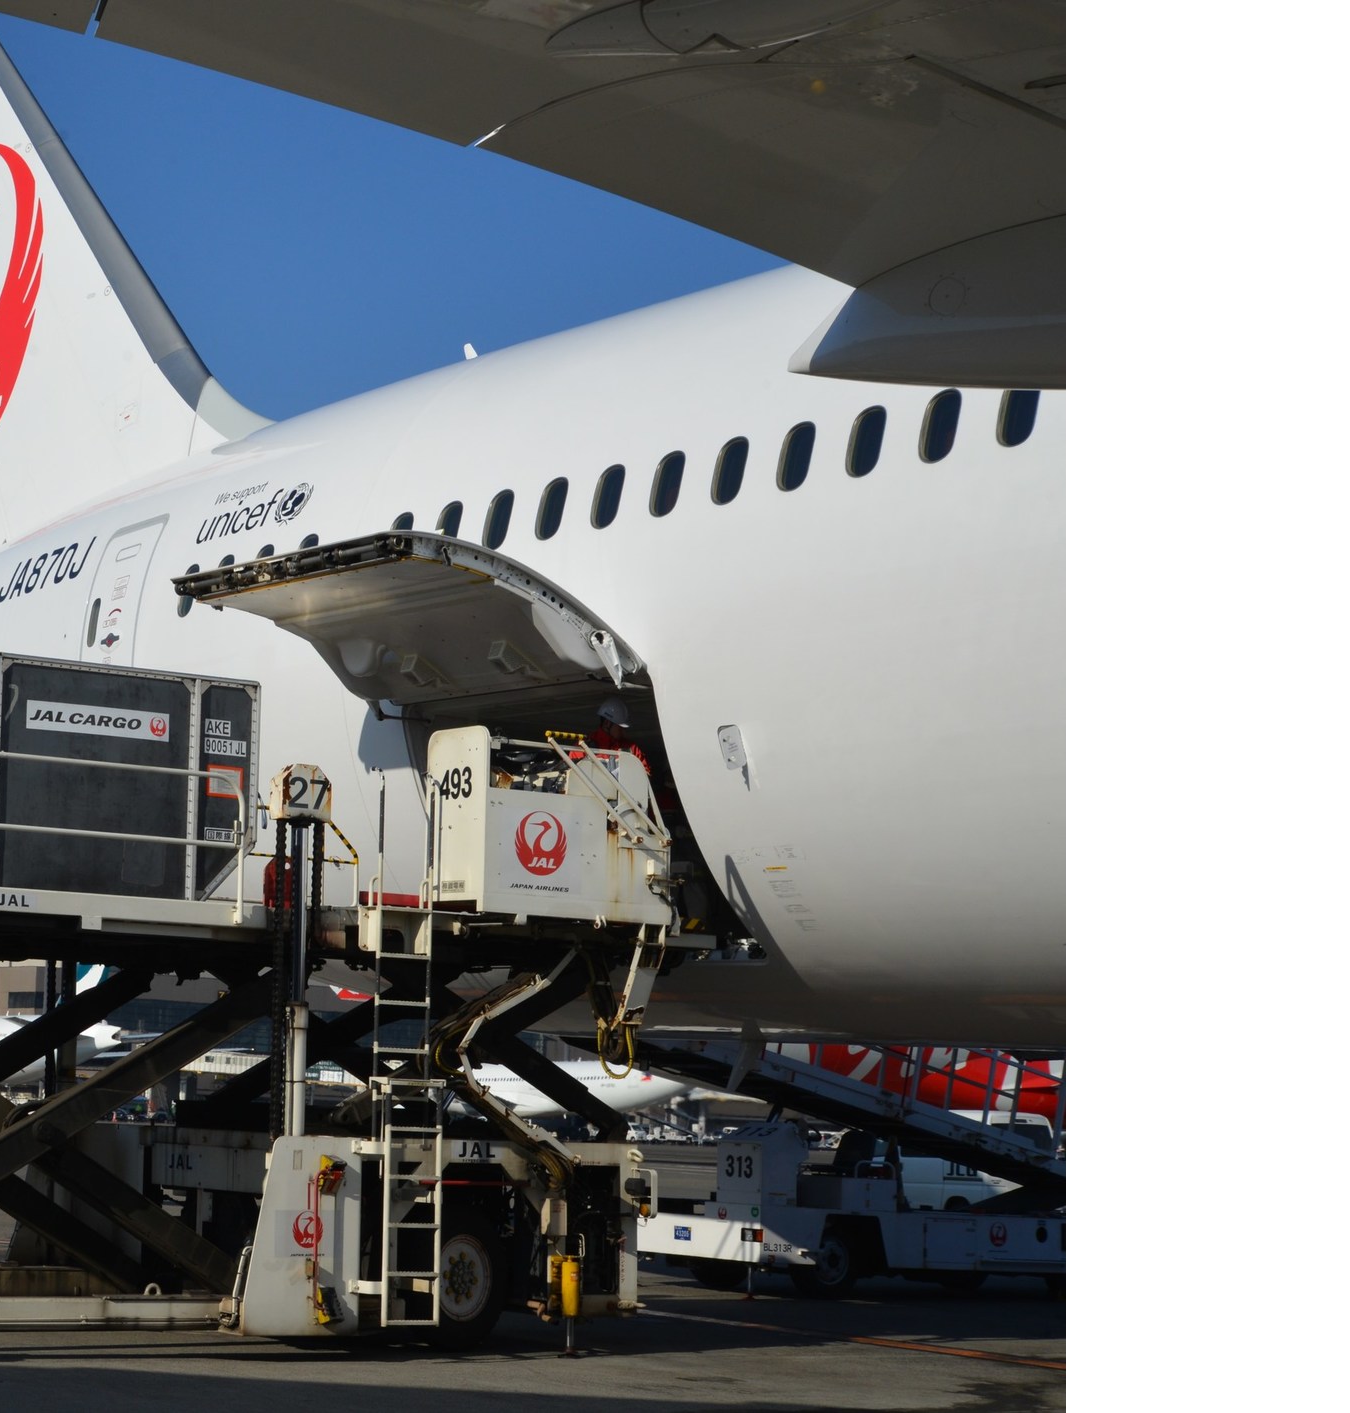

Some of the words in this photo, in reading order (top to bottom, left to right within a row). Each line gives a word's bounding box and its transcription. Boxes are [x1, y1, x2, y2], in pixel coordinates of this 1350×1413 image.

[215, 491, 230, 505] We
[231, 481, 269, 501] support
[196, 488, 284, 544] unicef
[206, 721, 230, 735] AKE
[440, 766, 472, 800] 493
[288, 777, 330, 810] 27
[528, 856, 557, 869] JAL
[535, 885, 570, 893] AIRLINES
[458, 1141, 496, 1158] JAL
[168, 1153, 193, 1170] JAL
[725, 1154, 753, 1178] 313
[763, 1243, 792, 1253] BL313R
